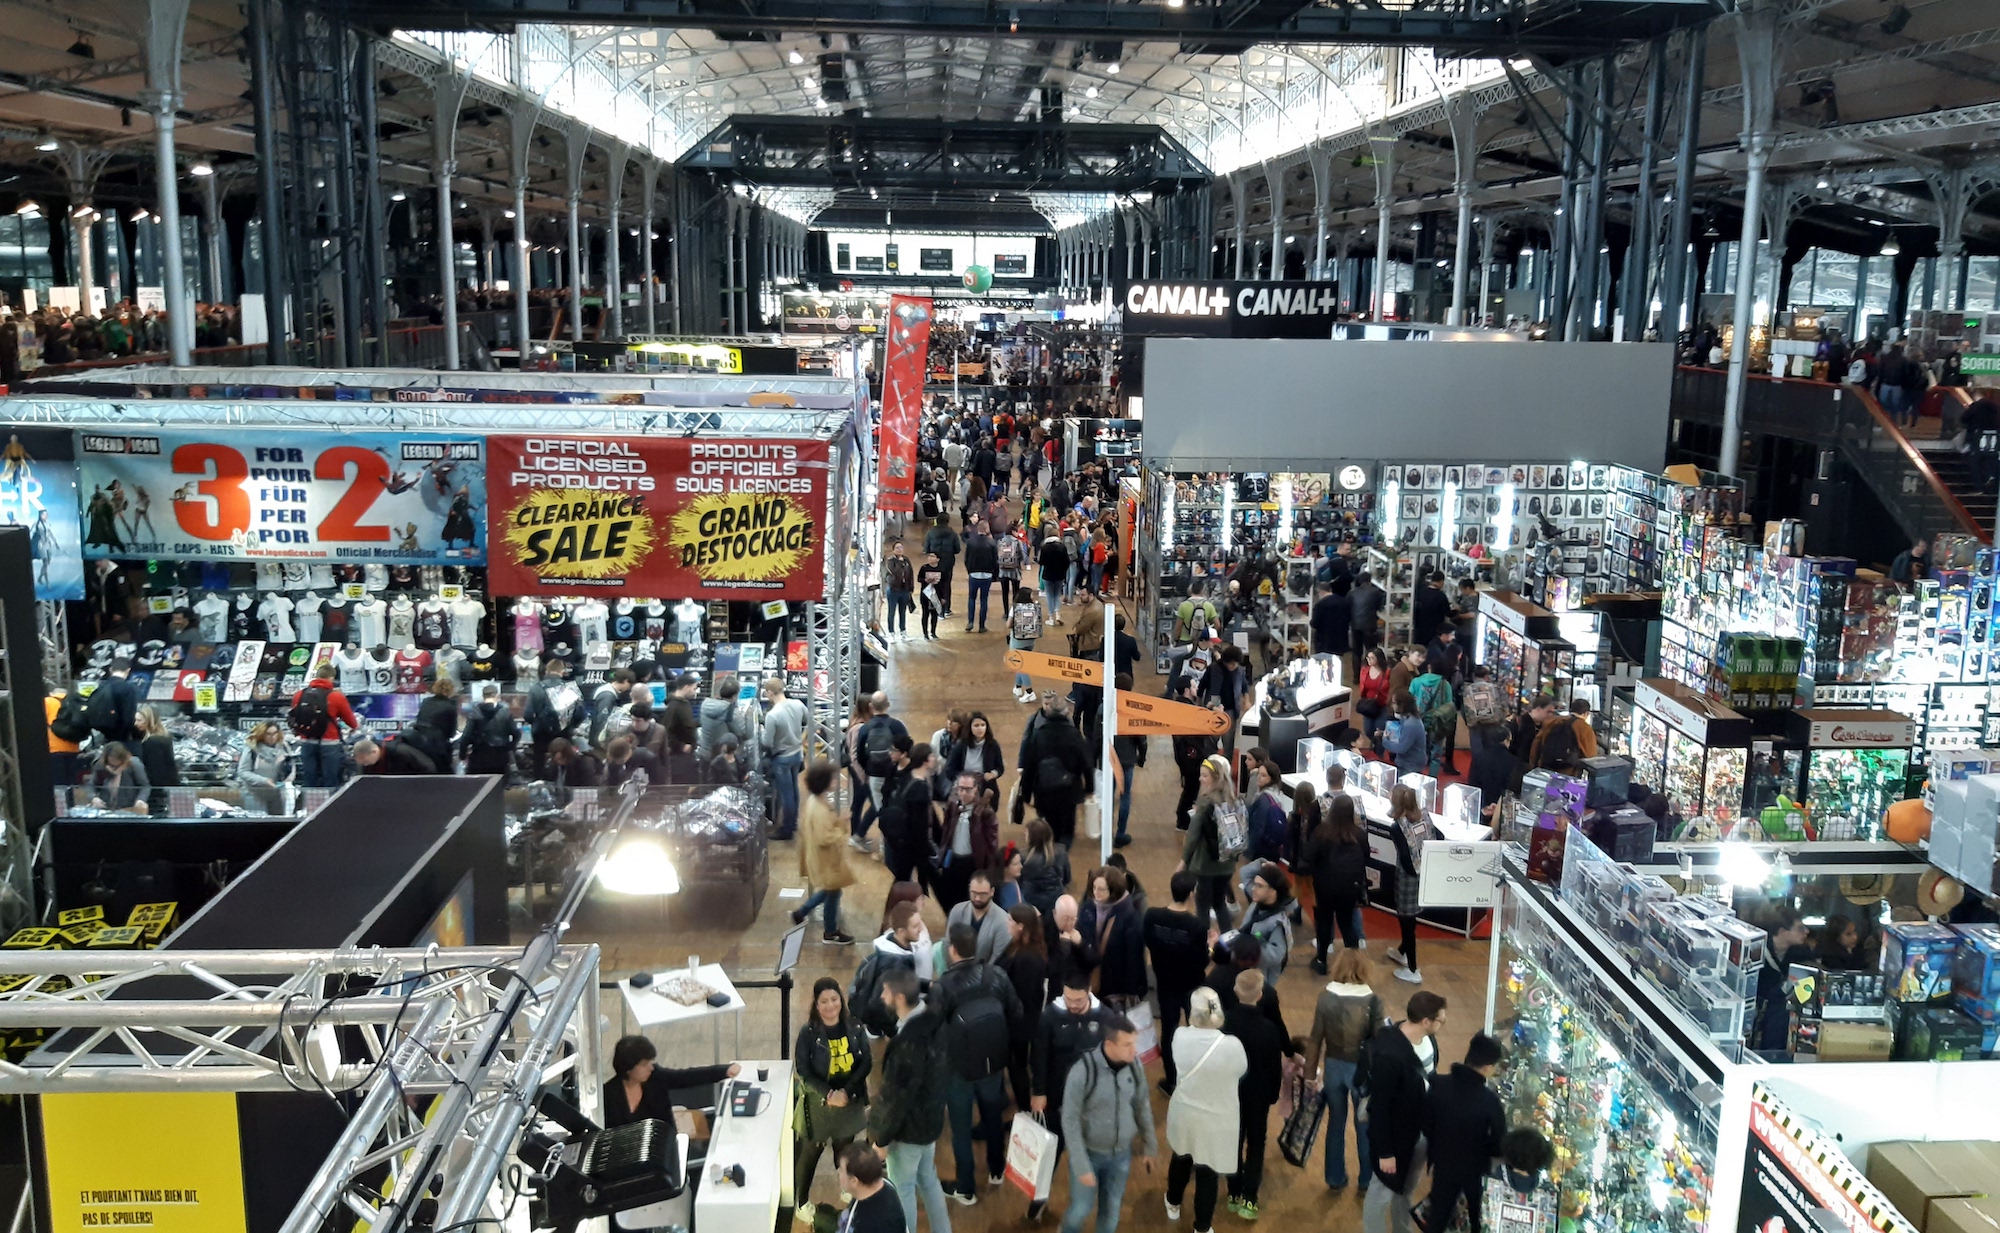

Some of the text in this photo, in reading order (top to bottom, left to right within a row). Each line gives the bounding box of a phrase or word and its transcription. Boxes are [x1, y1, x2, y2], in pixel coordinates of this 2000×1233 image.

[1127, 285, 1230, 316] CANAL+
[1237, 287, 1336, 317] CANAL+
[84, 436, 160, 454] LEGEND ICON
[402, 444, 478, 460] LEGEND ICON
[525, 438, 640, 457] OFFICIAL
[690, 444, 797, 459] PRODUITS
[256, 447, 304, 463] FOR
[519, 456, 647, 474] LICENSED
[690, 461, 798, 477] OFFICIELS
[251, 468, 312, 483] POUR
[511, 473, 656, 491] PRODUCTS
[172, 443, 251, 541] 3
[676, 477, 813, 494] SOUS LICENCES
[260, 486, 307, 502] FÜR
[314, 446, 391, 542] 2
[260, 509, 307, 523] PER
[516, 495, 645, 527] CLEARANCE
[699, 499, 788, 537] GRAND
[259, 529, 310, 543] POR
[524, 521, 634, 567] SALE
[174, 543, 201, 555] CAPS
[210, 544, 235, 556] HATS
[336, 547, 438, 558] Official Merchandise
[682, 522, 815, 567] DESTOCKAGE
[246, 549, 327, 558] www.legendicon.com
[540, 578, 624, 588] www.legendicon.com
[702, 580, 784, 590] www.legendicon.com
[1048, 658, 1083, 671] ARTIST ALLEY
[1126, 699, 1154, 712] WORKSHOP
[1128, 718, 1170, 727] RESTAUR
[80, 1190, 90, 1203] ET
[92, 1190, 132, 1202] POURTANT
[134, 1190, 162, 1202] T'AVAIS
[164, 1190, 182, 1202] BIEN
[82, 1212, 154, 1225] PAS DE SPOILERS!
[1502, 1205, 1532, 1223] MARVEL
